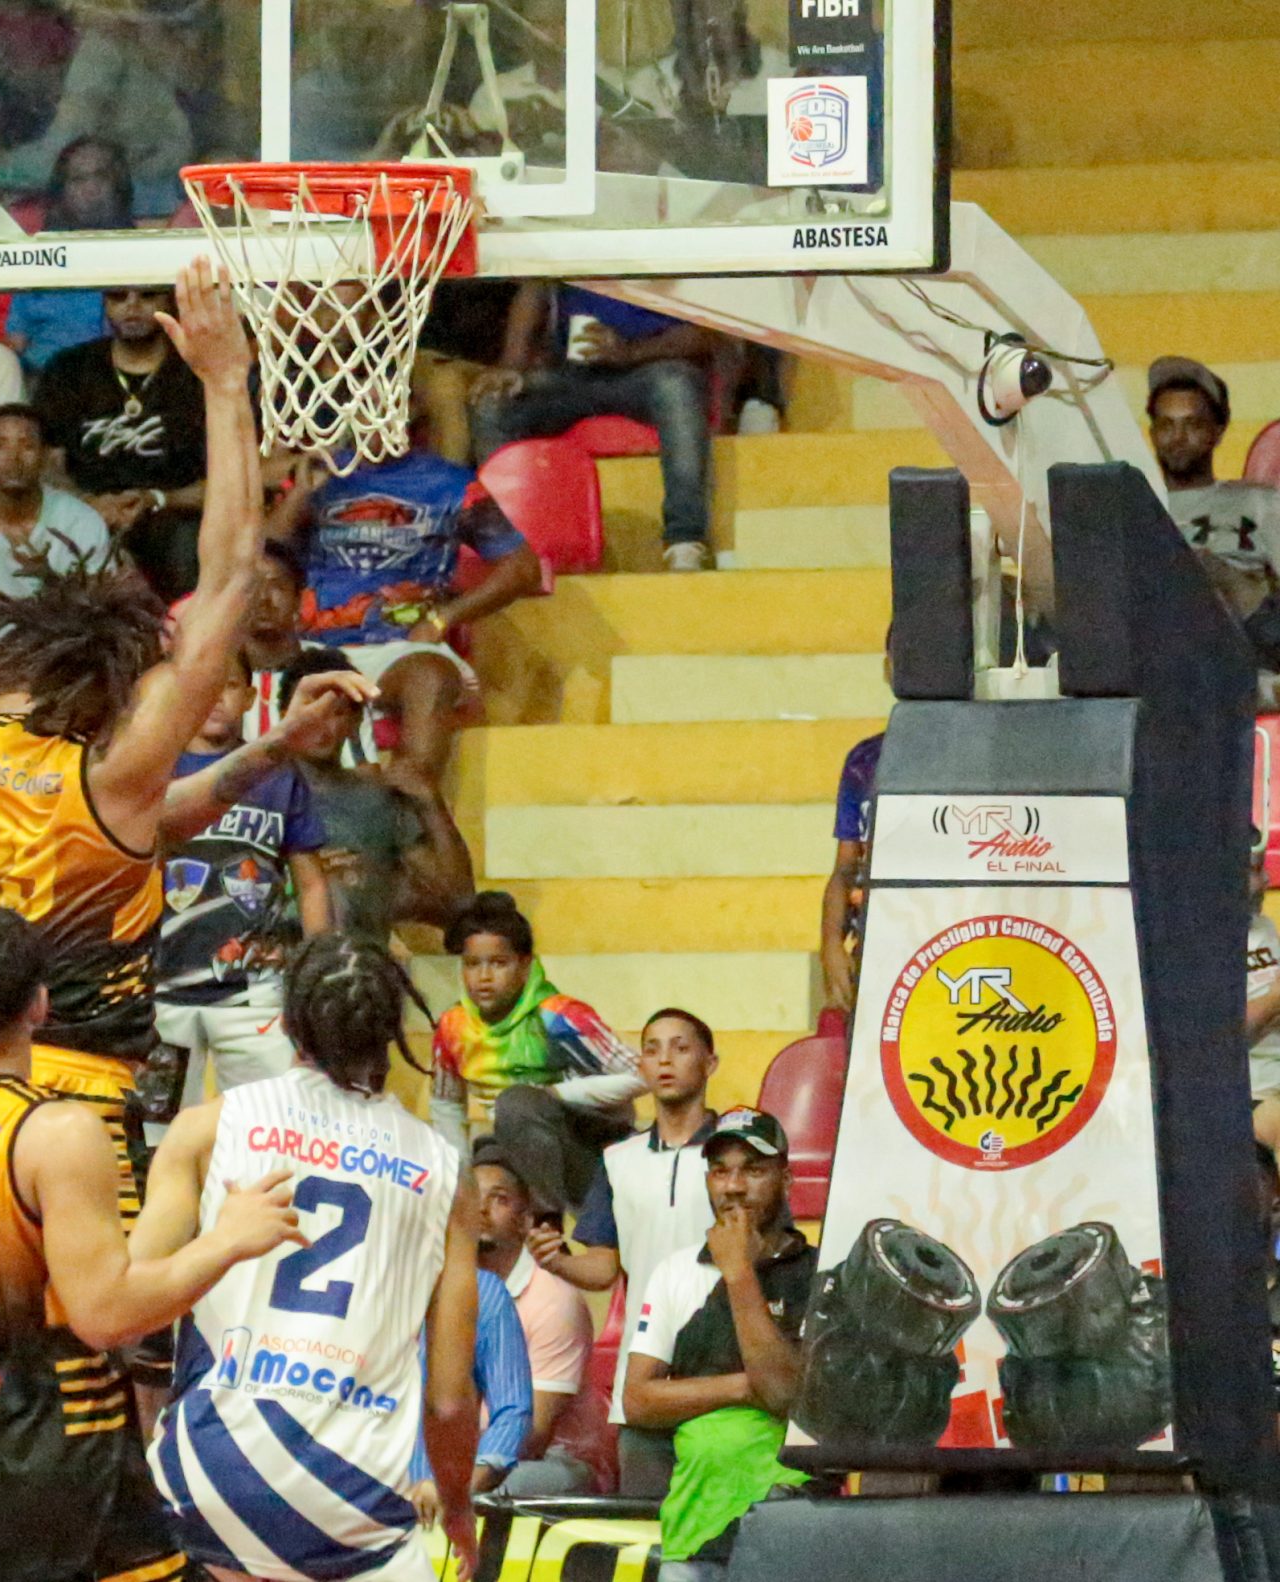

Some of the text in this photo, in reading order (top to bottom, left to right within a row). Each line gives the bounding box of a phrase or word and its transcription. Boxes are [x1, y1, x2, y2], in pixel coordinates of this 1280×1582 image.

[802, 0, 859, 18] FIBA
[793, 227, 888, 249] ABASTESA
[968, 829, 1055, 859] Audio
[987, 861, 1066, 873] EL FINAL
[882, 917, 1114, 1042] Marca de Prestigio y Calidad Garantizada
[957, 997, 1065, 1035] Audio
[269, 1175, 373, 1320] 2
